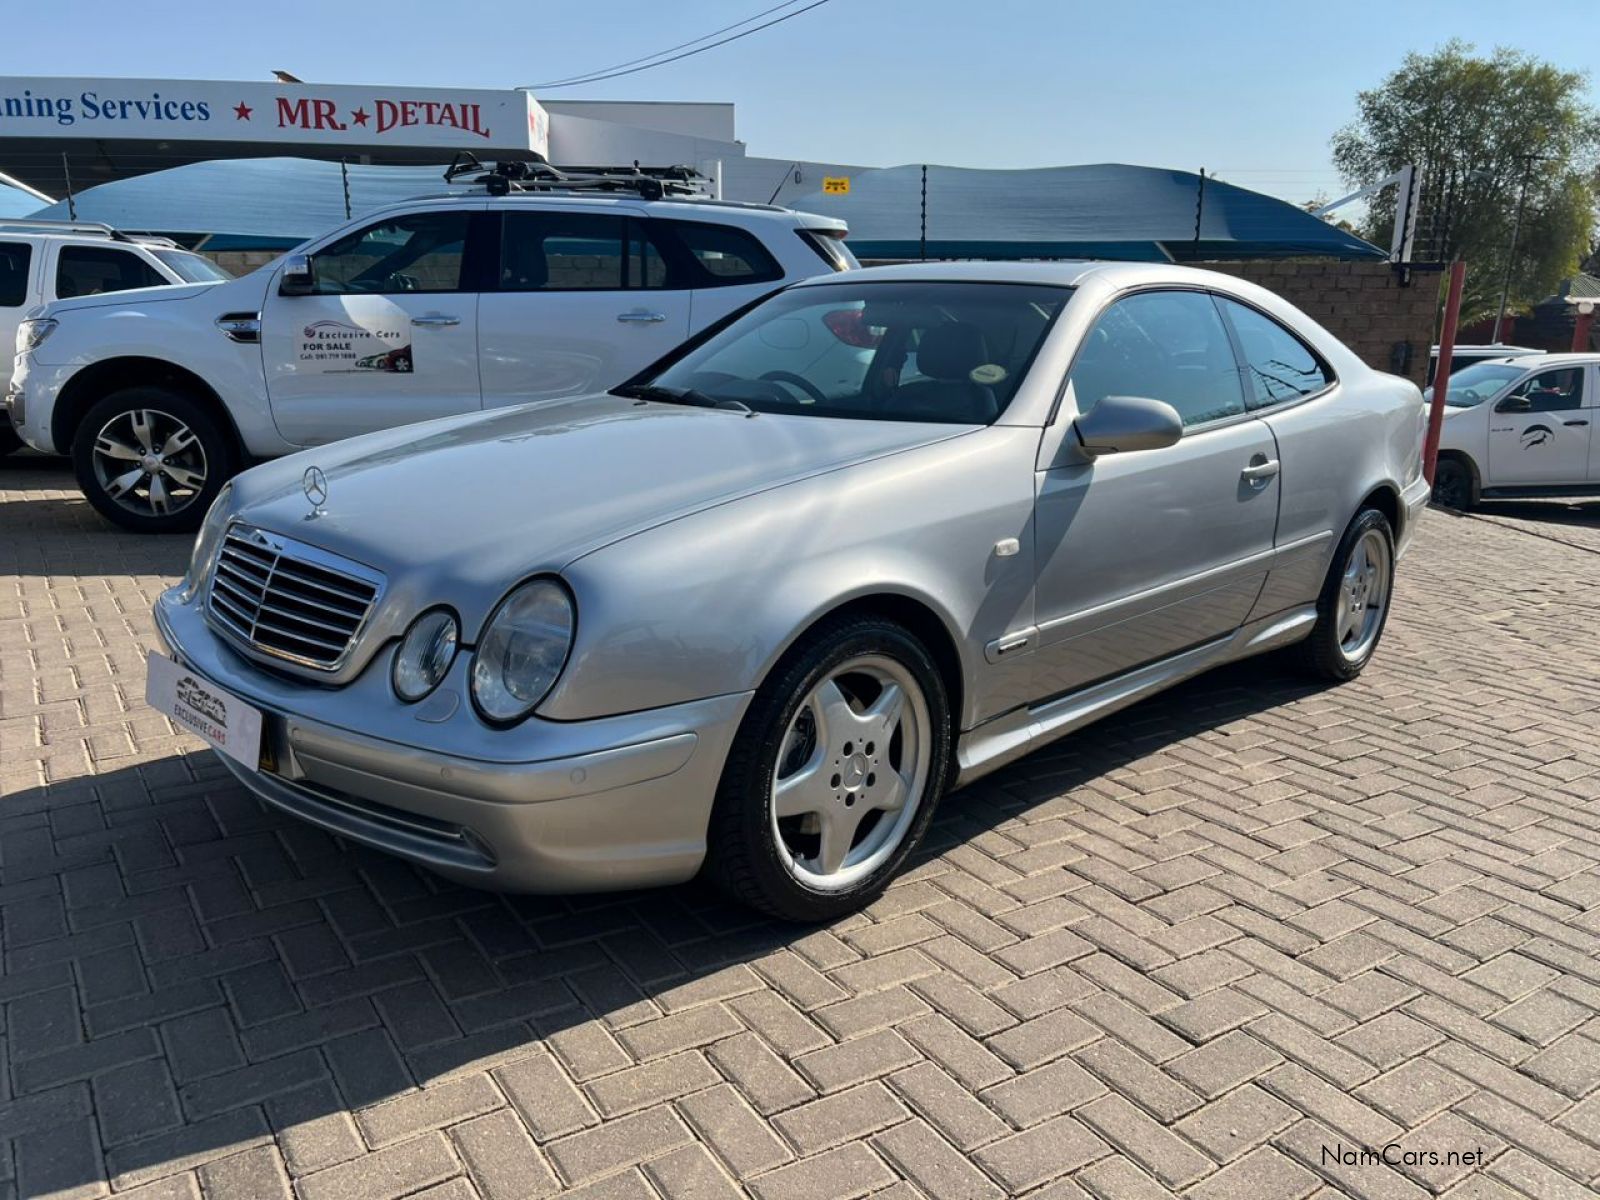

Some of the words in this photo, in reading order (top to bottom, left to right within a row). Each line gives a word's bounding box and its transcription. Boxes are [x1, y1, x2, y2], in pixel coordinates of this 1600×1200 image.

[80, 91, 211, 121] Services
[275, 97, 348, 131] MR.
[374, 99, 490, 139] DETAIL
[319, 330, 371, 340] Exclusive
[375, 330, 401, 339] Cars
[303, 342, 324, 351] FOR
[326, 342, 352, 351] SALE
